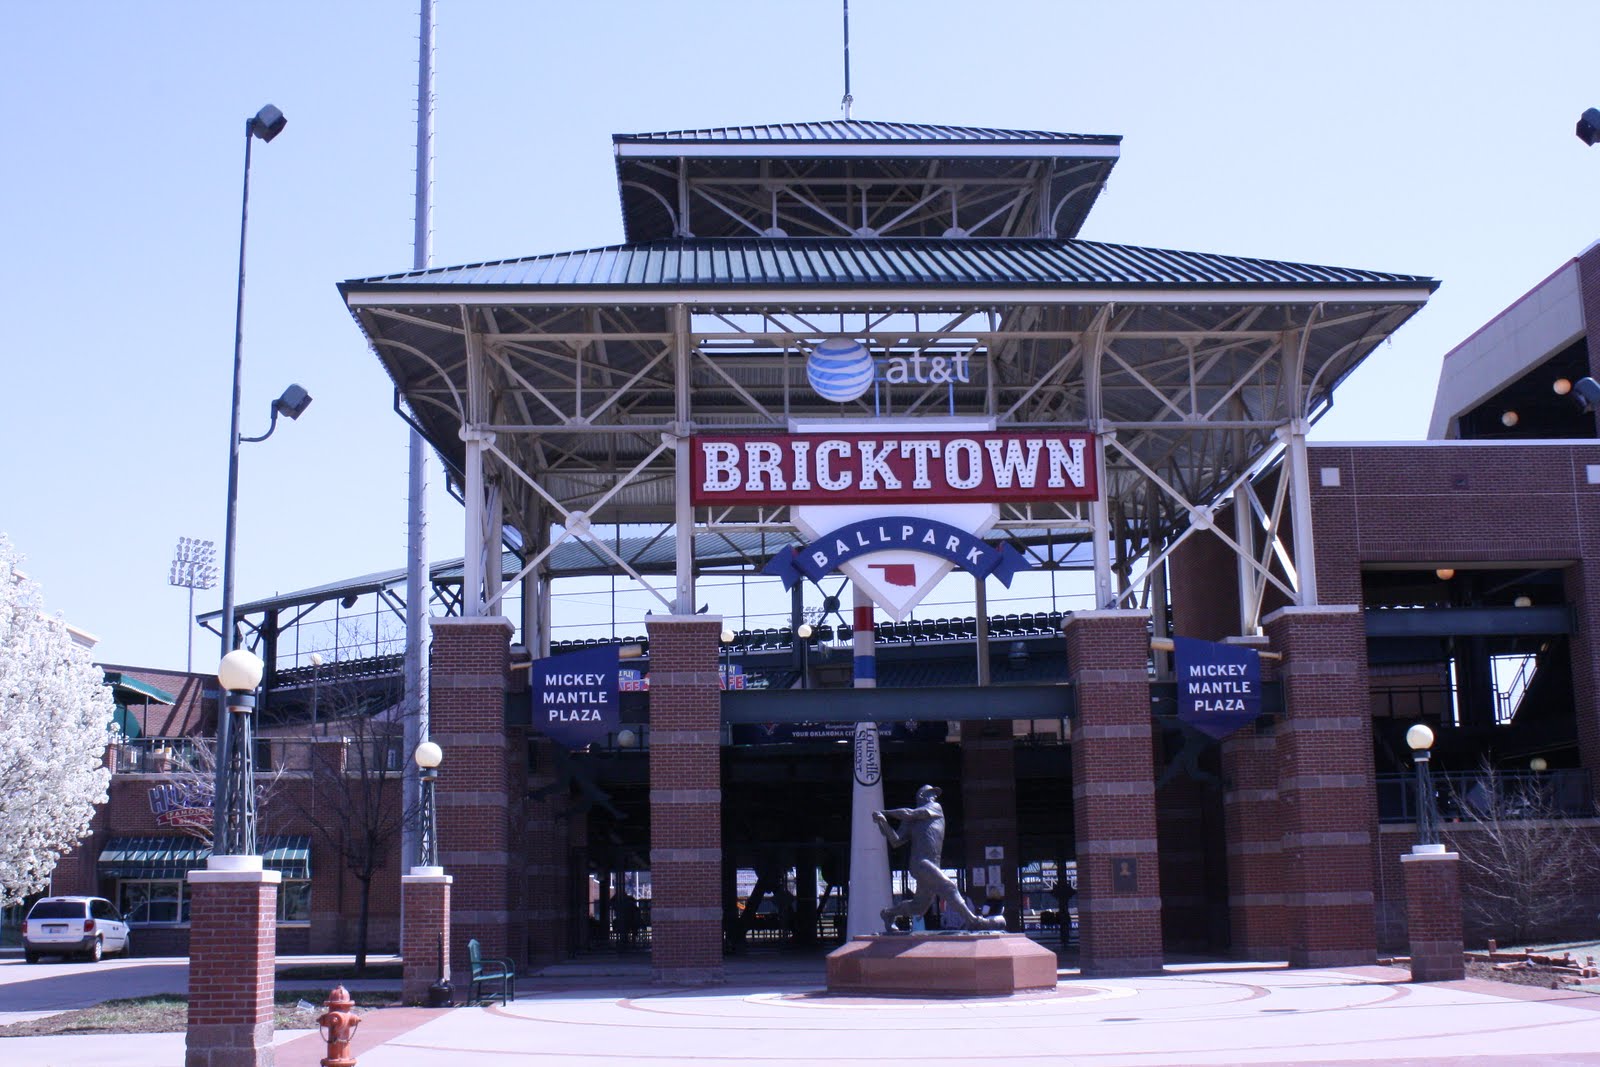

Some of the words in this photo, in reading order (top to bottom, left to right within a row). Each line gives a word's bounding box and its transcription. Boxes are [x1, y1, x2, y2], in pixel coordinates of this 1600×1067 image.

[886, 351, 969, 383] at&t
[702, 439, 1086, 491] BRICKTOWN
[812, 525, 983, 568] BALLPARK
[1190, 664, 1247, 676] MICKEY
[545, 674, 605, 686] MICKEY
[1189, 682, 1251, 694] MANTLE
[543, 692, 608, 703] MANTLE
[1195, 699, 1245, 711] PLAZA
[549, 710, 602, 721] PLAZA
[866, 728, 879, 781] Louisville
